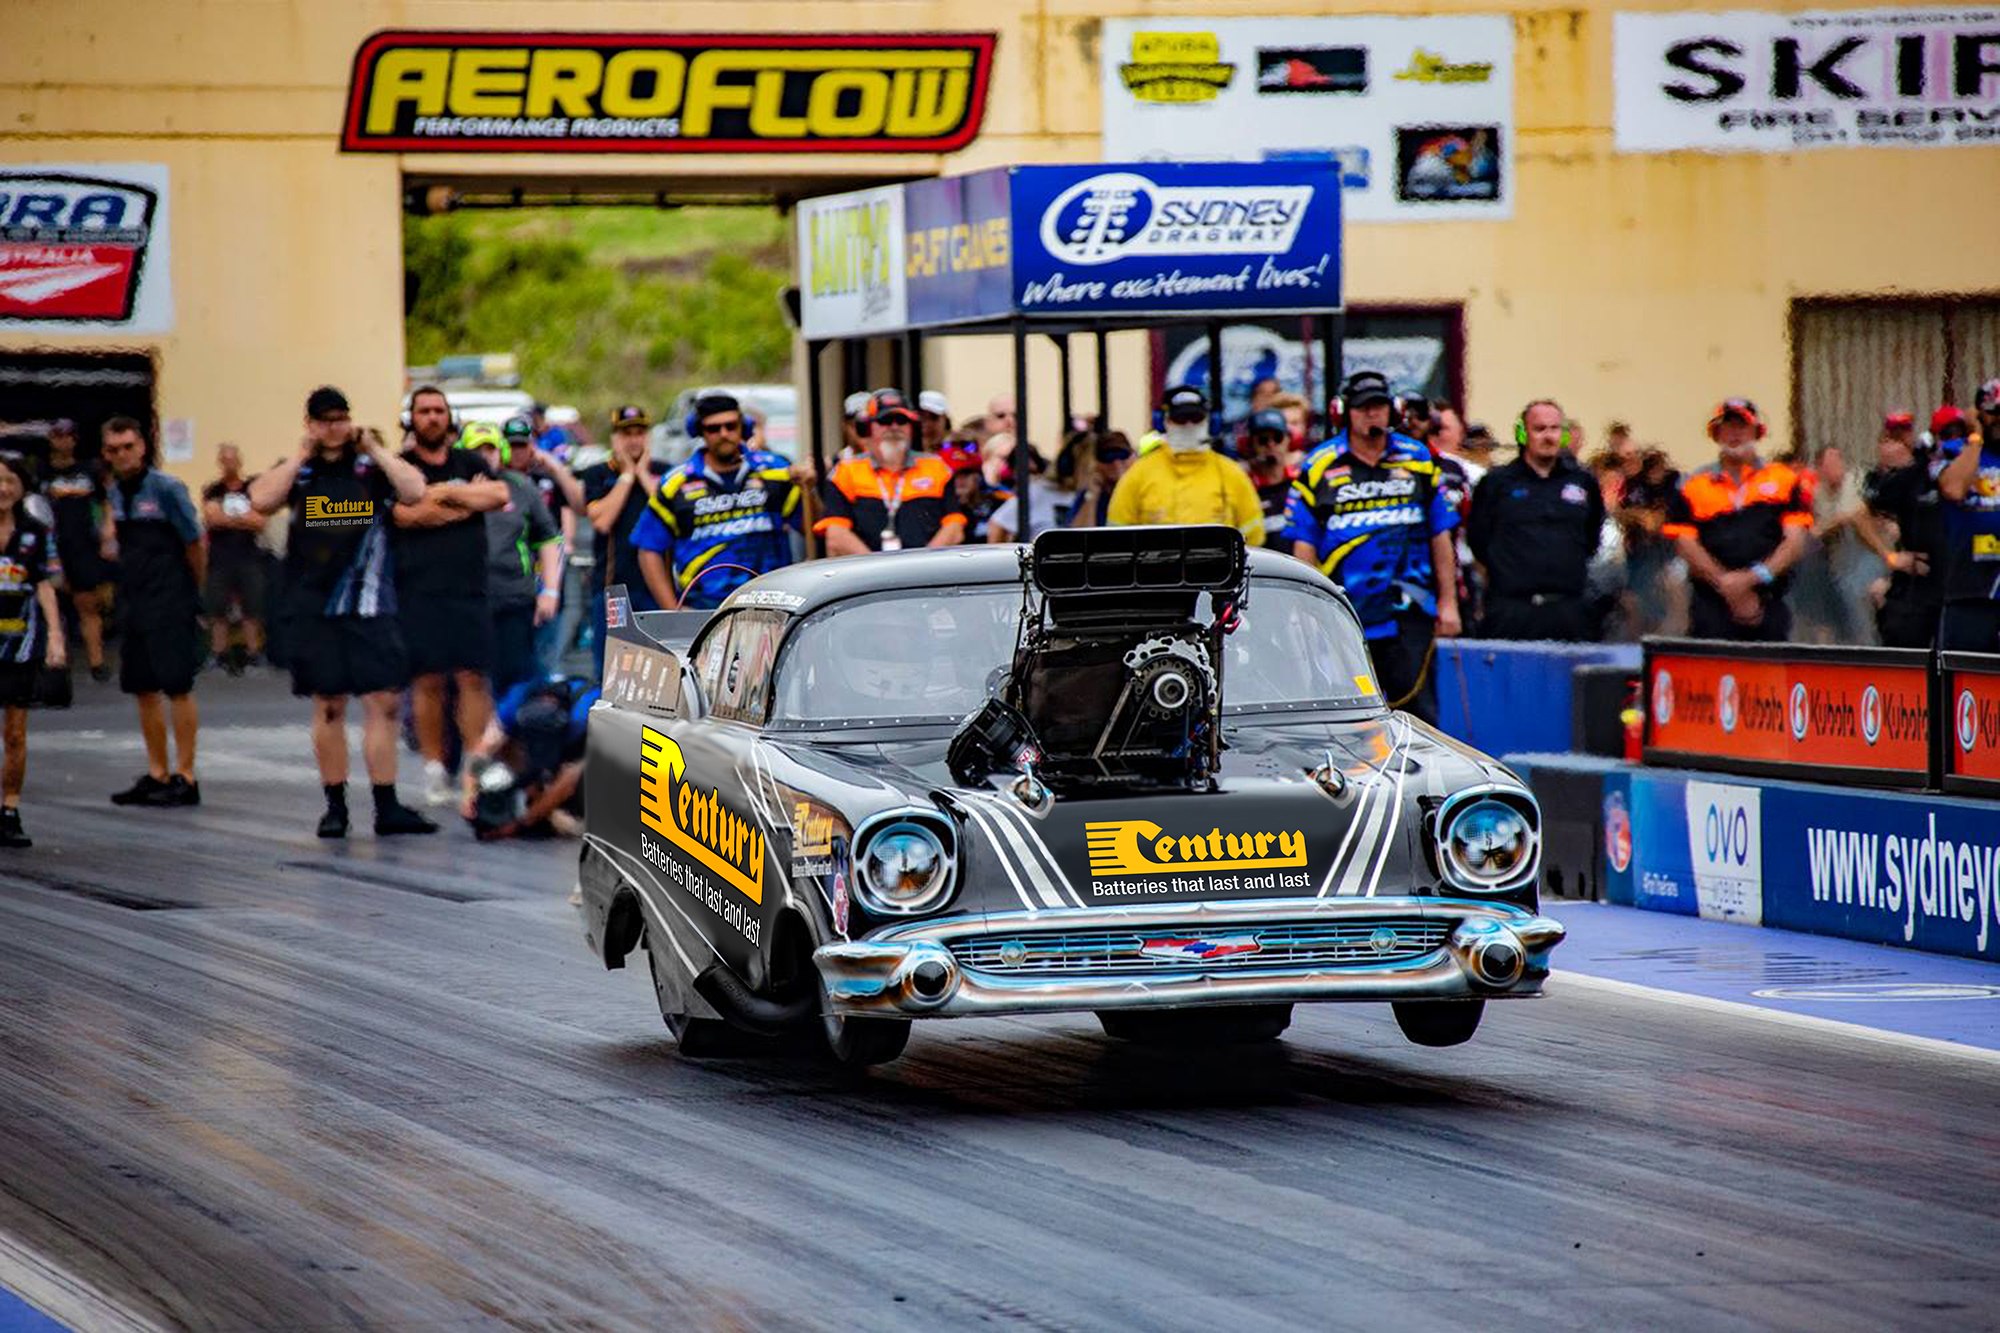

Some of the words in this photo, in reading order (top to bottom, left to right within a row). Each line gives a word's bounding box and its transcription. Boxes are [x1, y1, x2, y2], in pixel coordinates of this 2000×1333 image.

[366, 48, 974, 137] AEROFLOW
[413, 117, 568, 137] PERFORMANCE
[570, 117, 679, 137] PRODUCTS
[0, 192, 126, 226] RA
[1156, 199, 1300, 227] SYDNEY
[1149, 229, 1284, 243] DRAGWAY
[1022, 271, 1106, 306] Where
[1111, 265, 1252, 298] excitement
[1256, 253, 1331, 290] lives!
[306, 495, 374, 519] Century
[1335, 479, 1416, 503] SYDNEY
[305, 520, 329, 528] Batteries
[341, 518, 352, 526] last
[363, 517, 374, 525] last
[1810, 688, 1856, 738] Kubota
[1980, 693, 2000, 748] Ku
[639, 723, 766, 906] Century
[1706, 802, 1748, 866] OVO
[1085, 819, 1308, 877] Century
[641, 832, 684, 886] Batteries
[685, 864, 704, 902] that
[705, 878, 723, 917] last
[724, 899, 742, 932] and
[743, 907, 761, 947] last
[1092, 878, 1168, 897] Batteries
[1171, 876, 1206, 893] that
[1208, 875, 1240, 891] last
[1244, 873, 1275, 890] and
[1279, 871, 1311, 888] last
